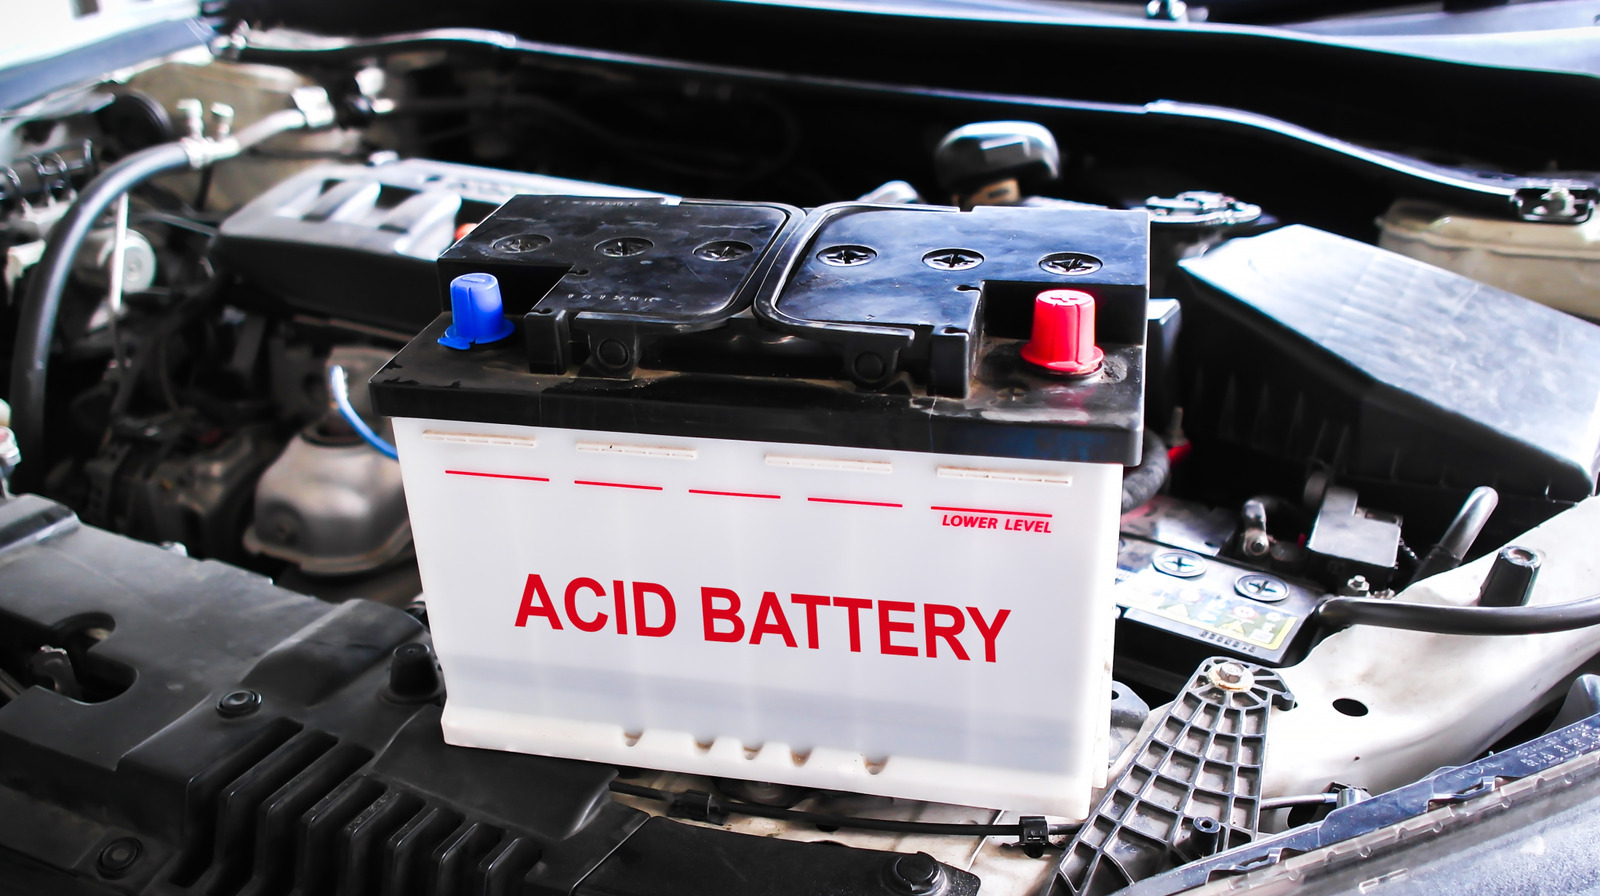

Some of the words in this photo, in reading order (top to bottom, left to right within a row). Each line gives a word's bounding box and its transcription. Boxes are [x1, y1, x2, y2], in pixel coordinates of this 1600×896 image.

[942, 515, 998, 530] LOWER
[1004, 518, 1052, 534] LEVEL
[514, 573, 677, 638] ACID
[700, 586, 1012, 664] BATTERY
